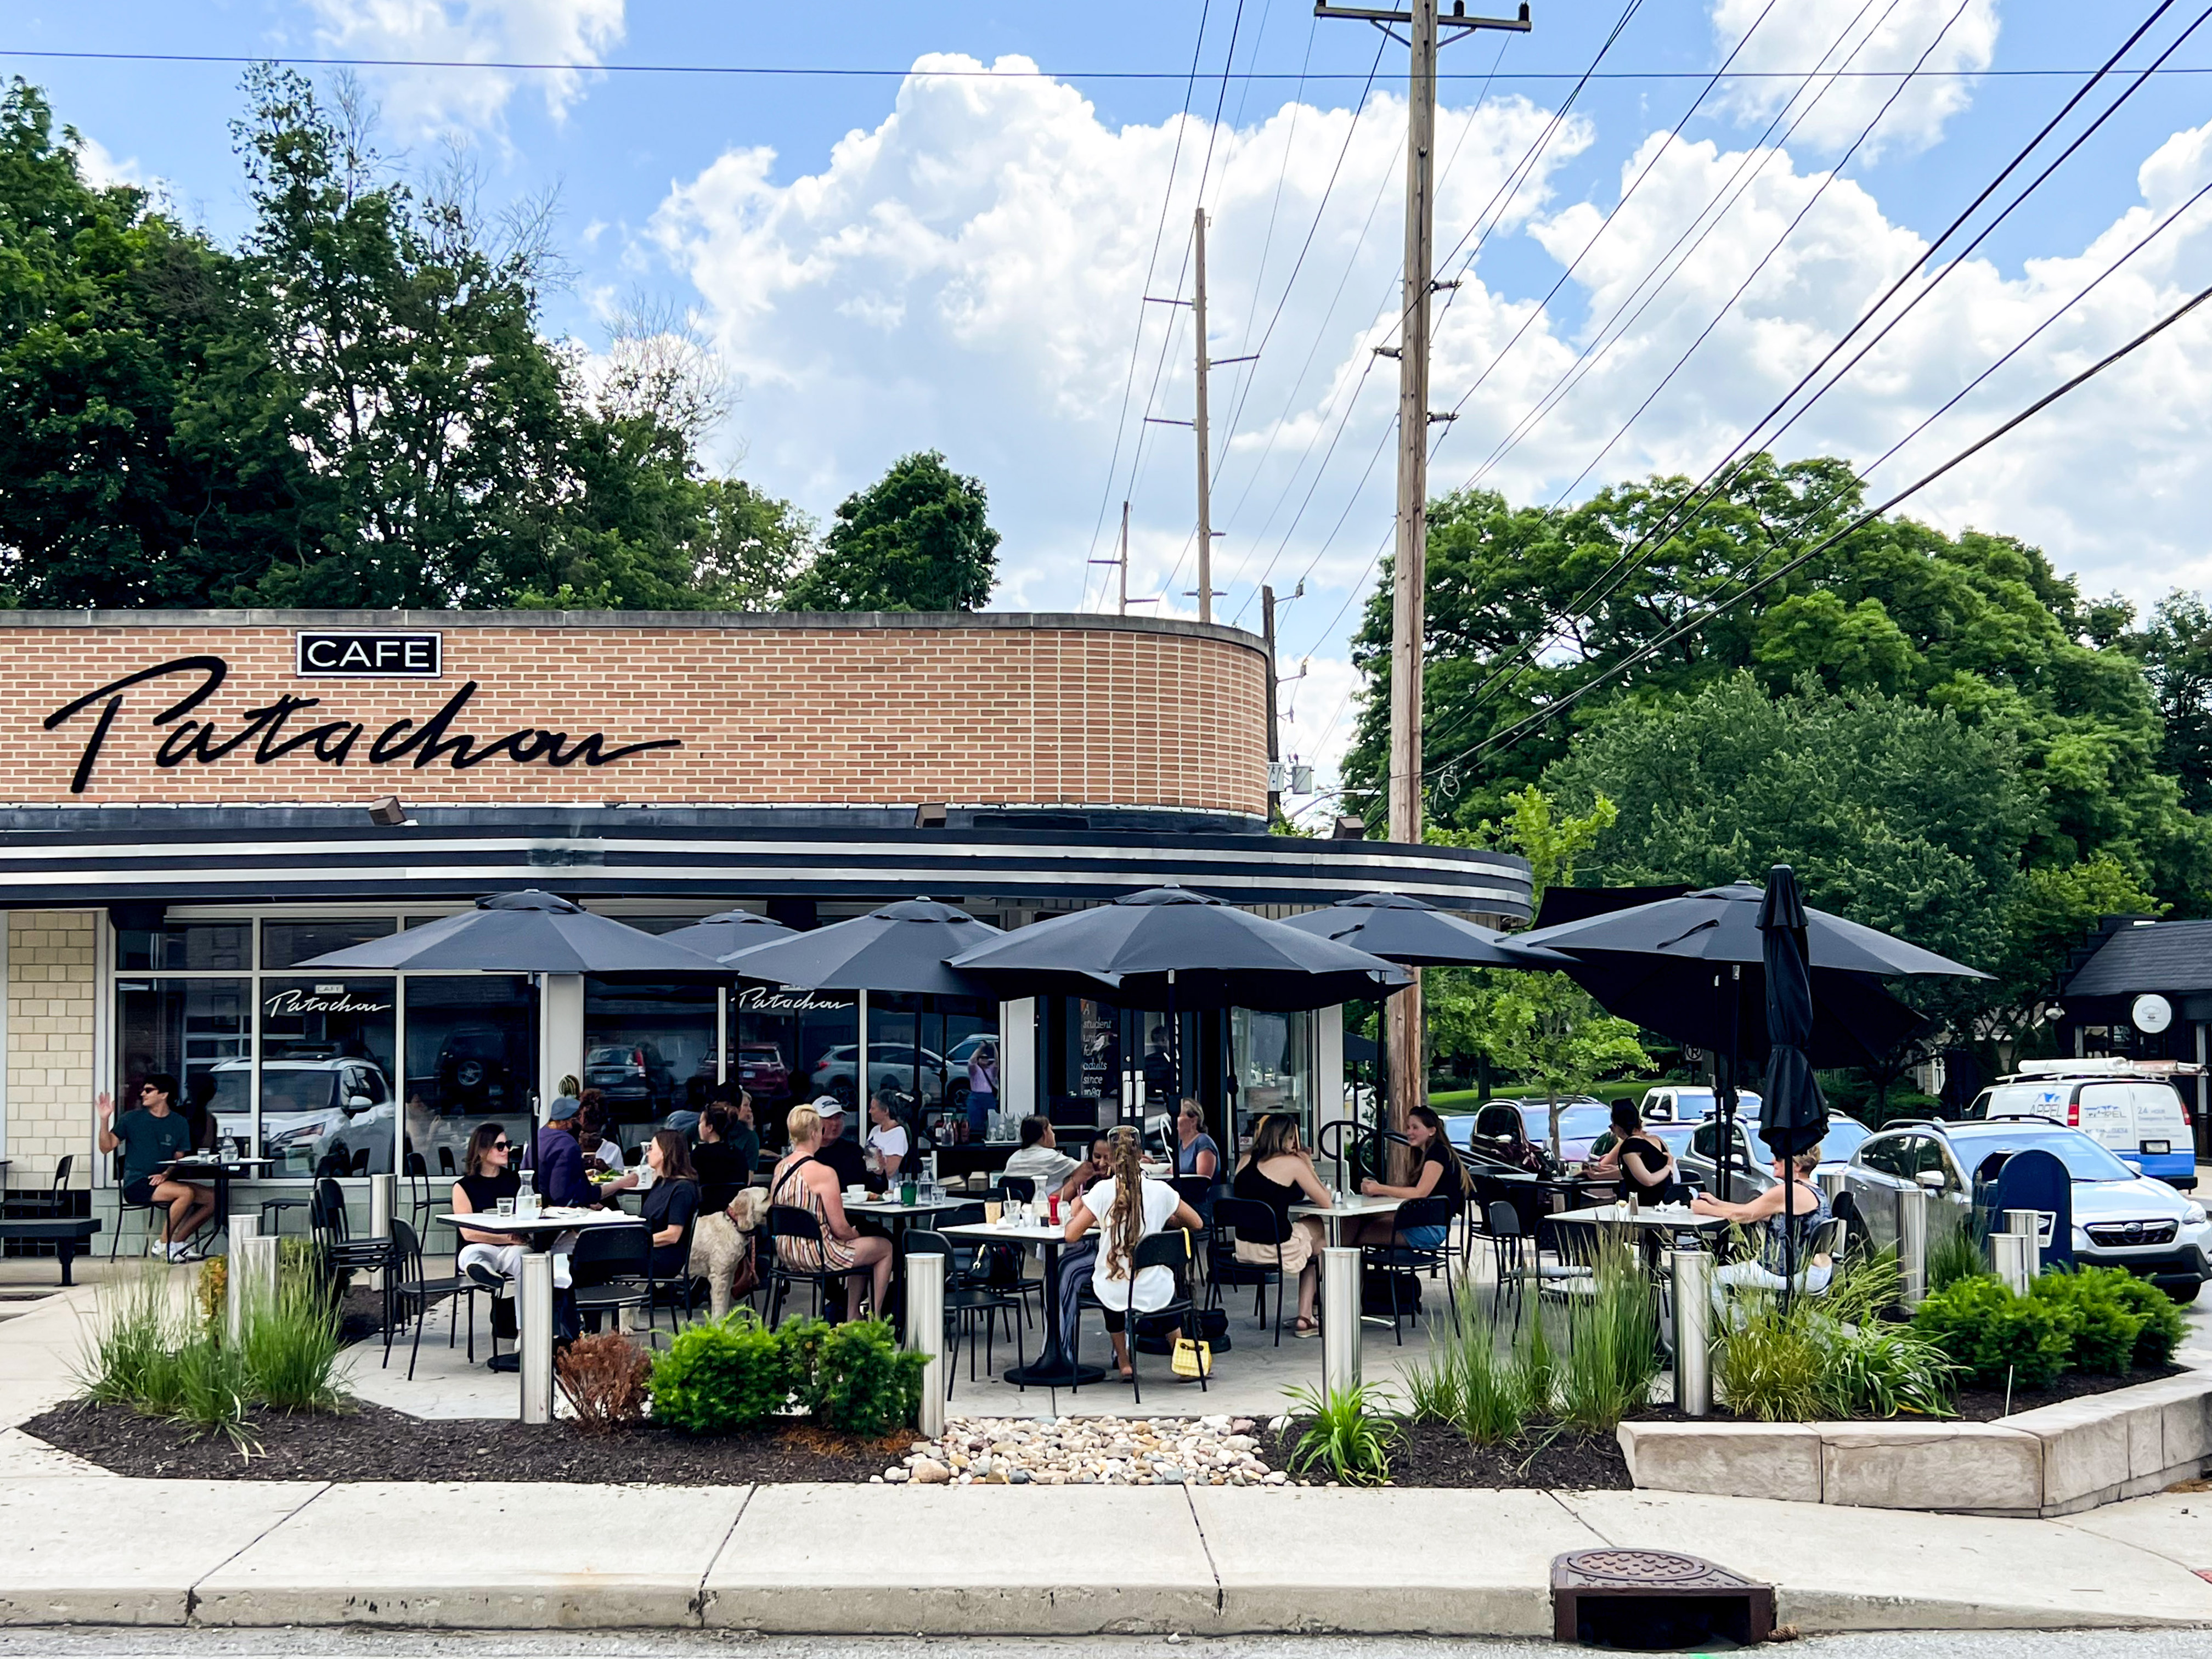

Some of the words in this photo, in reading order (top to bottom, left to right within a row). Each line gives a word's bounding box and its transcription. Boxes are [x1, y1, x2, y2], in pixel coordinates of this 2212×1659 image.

[307, 640, 430, 668] CAFE
[43, 655, 681, 793] Patachou
[264, 989, 392, 1018] Patachou
[730, 986, 854, 1009] Patachou
[1083, 1016, 1112, 1029] student
[1083, 1074, 1103, 1085] since
